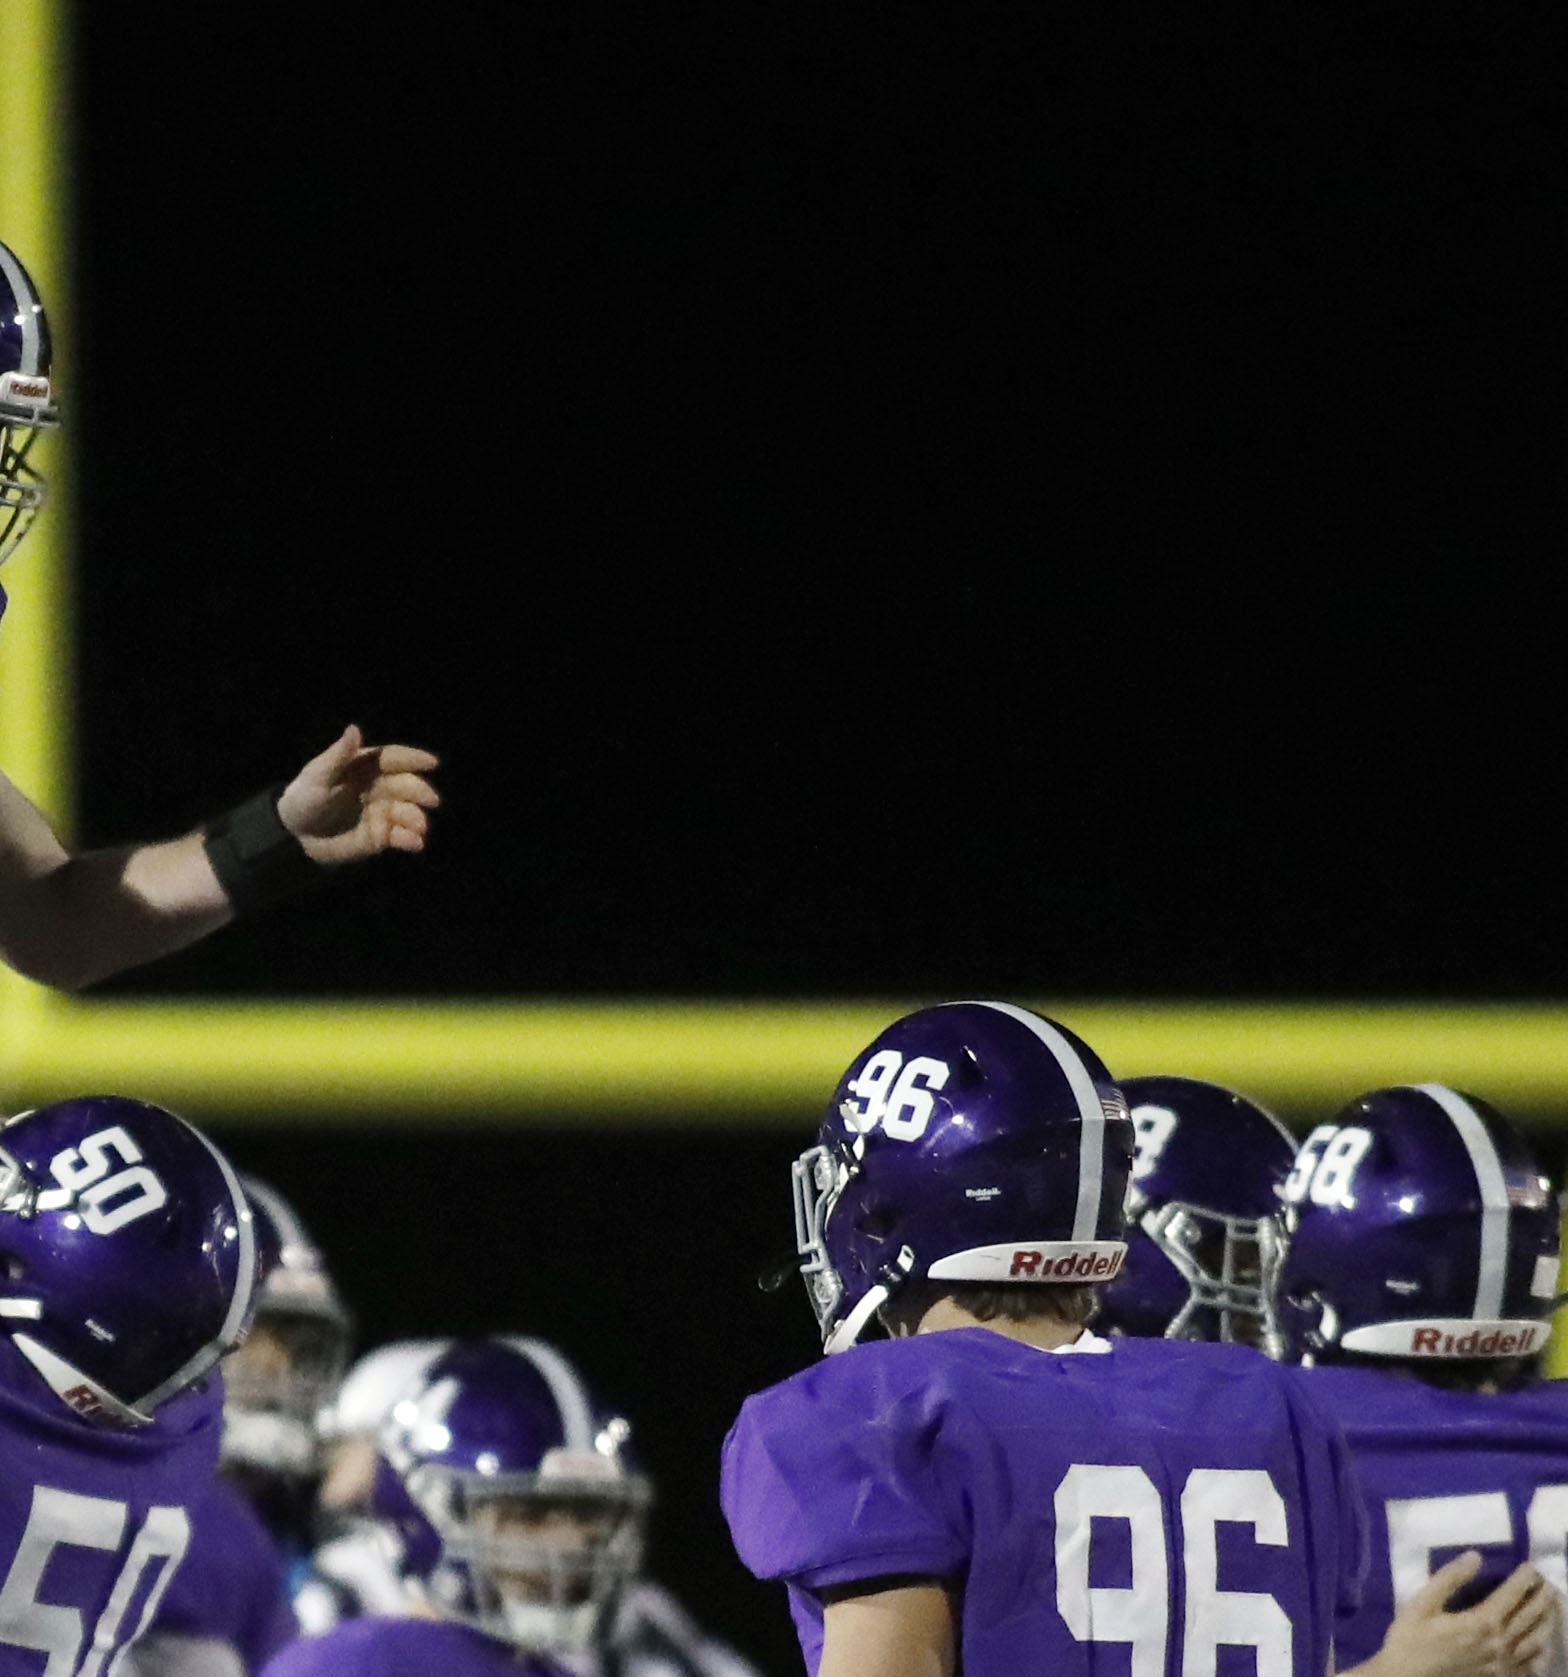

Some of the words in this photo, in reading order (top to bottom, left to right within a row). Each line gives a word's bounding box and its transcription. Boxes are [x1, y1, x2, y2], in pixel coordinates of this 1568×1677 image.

[844, 1050, 950, 1142] 96
[49, 1126, 166, 1235] 50
[1285, 1126, 1372, 1205] 58
[1011, 1251, 1124, 1278] Riddell
[1413, 1327, 1537, 1354] Riddell
